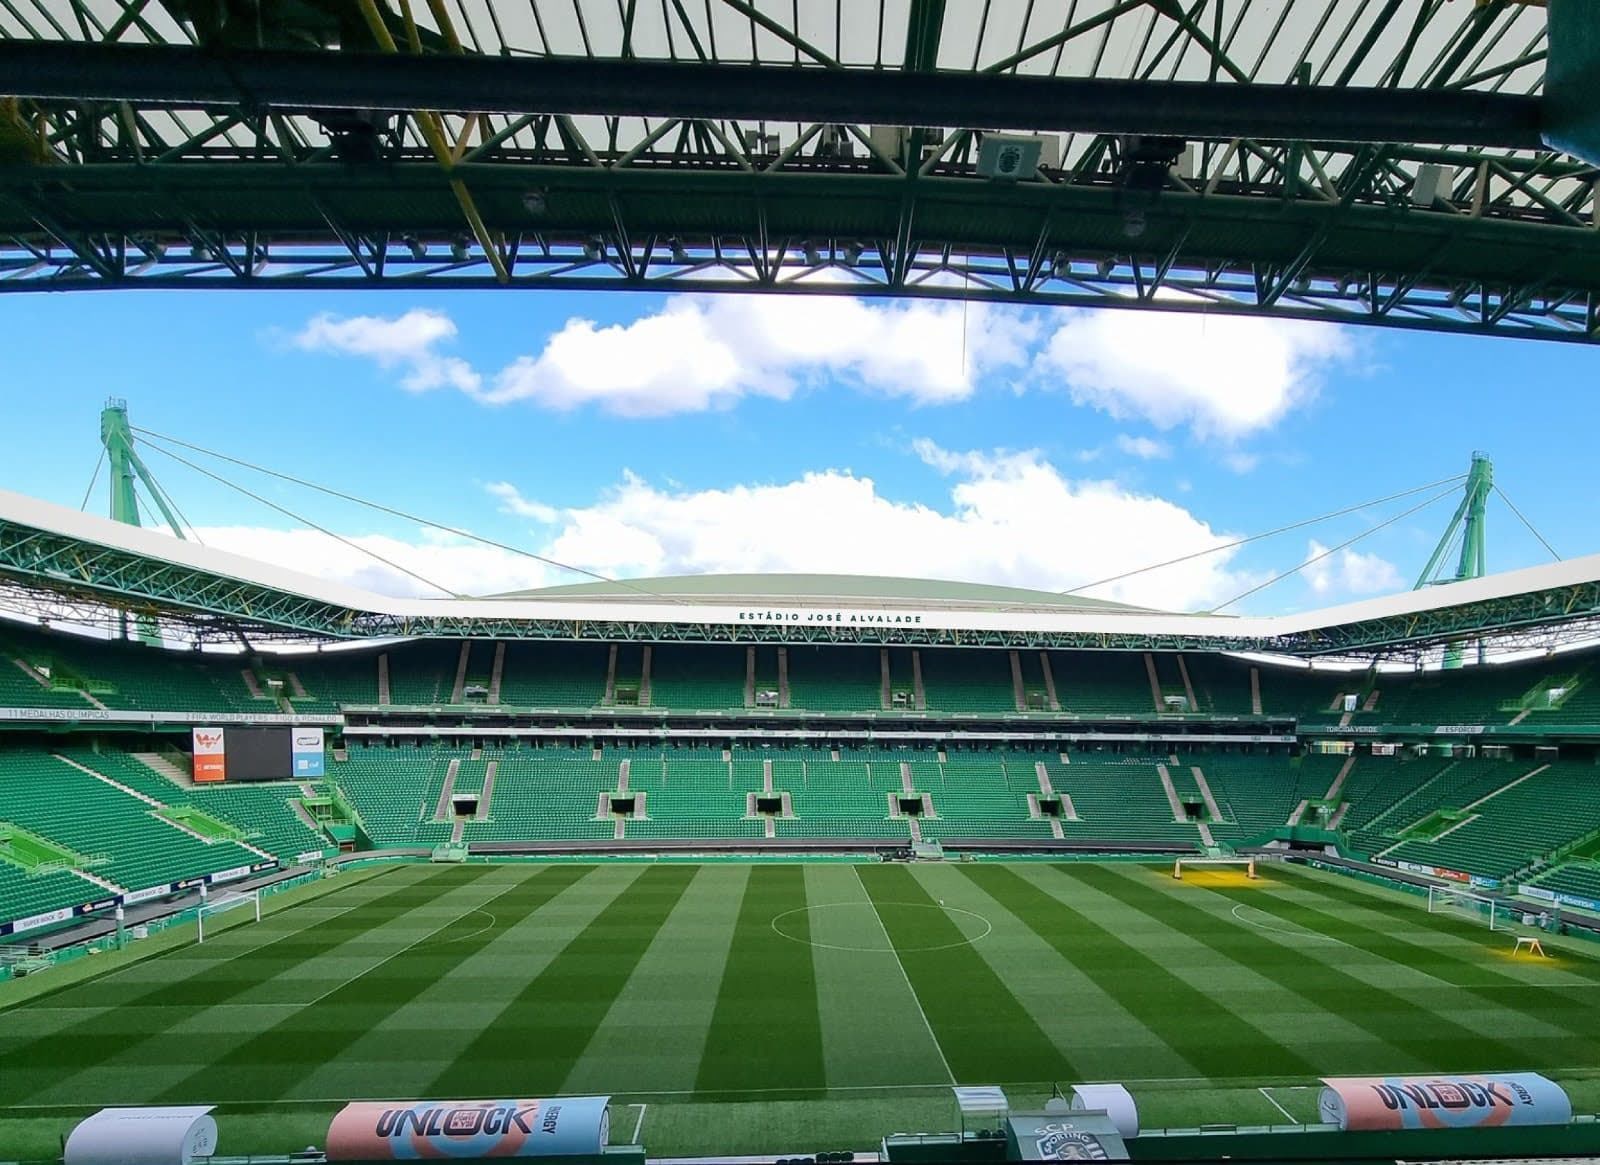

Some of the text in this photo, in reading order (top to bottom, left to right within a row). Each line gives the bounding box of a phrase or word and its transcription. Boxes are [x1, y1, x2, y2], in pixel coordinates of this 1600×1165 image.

[739, 611, 921, 623] ESTÁDIO JOSÉ ALVALADE
[20, 709, 65, 718] MEDALHAS
[1560, 893, 1595, 908] Hisense
[1371, 1082, 1514, 1110] UNLOCK
[376, 1107, 537, 1137] UNLOCK
[541, 1105, 562, 1134] ENERGY
[1043, 1131, 1091, 1154] SPORTING
